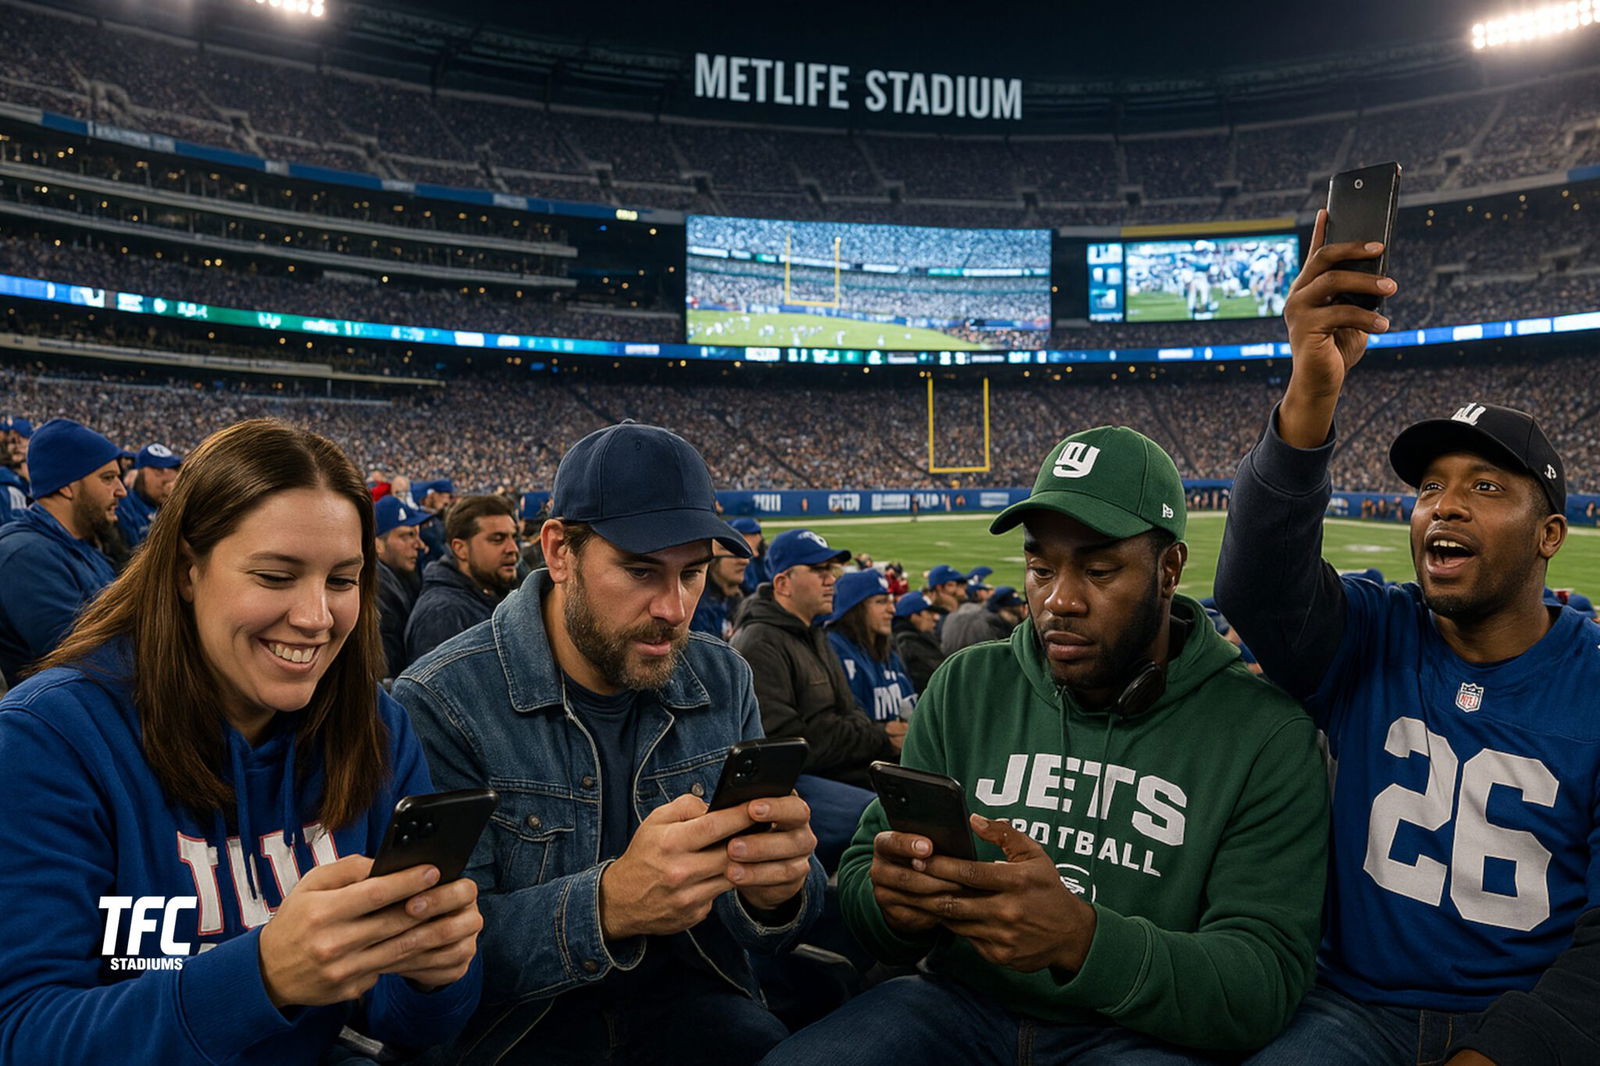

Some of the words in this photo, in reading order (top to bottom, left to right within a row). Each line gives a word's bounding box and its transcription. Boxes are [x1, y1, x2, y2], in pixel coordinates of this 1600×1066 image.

[695, 52, 849, 109] METLIFE
[865, 69, 1022, 120] STADIUM
[975, 753, 1188, 847] JETS
[1363, 716, 1560, 932] 26
[996, 818, 1161, 877] OOTBALL
